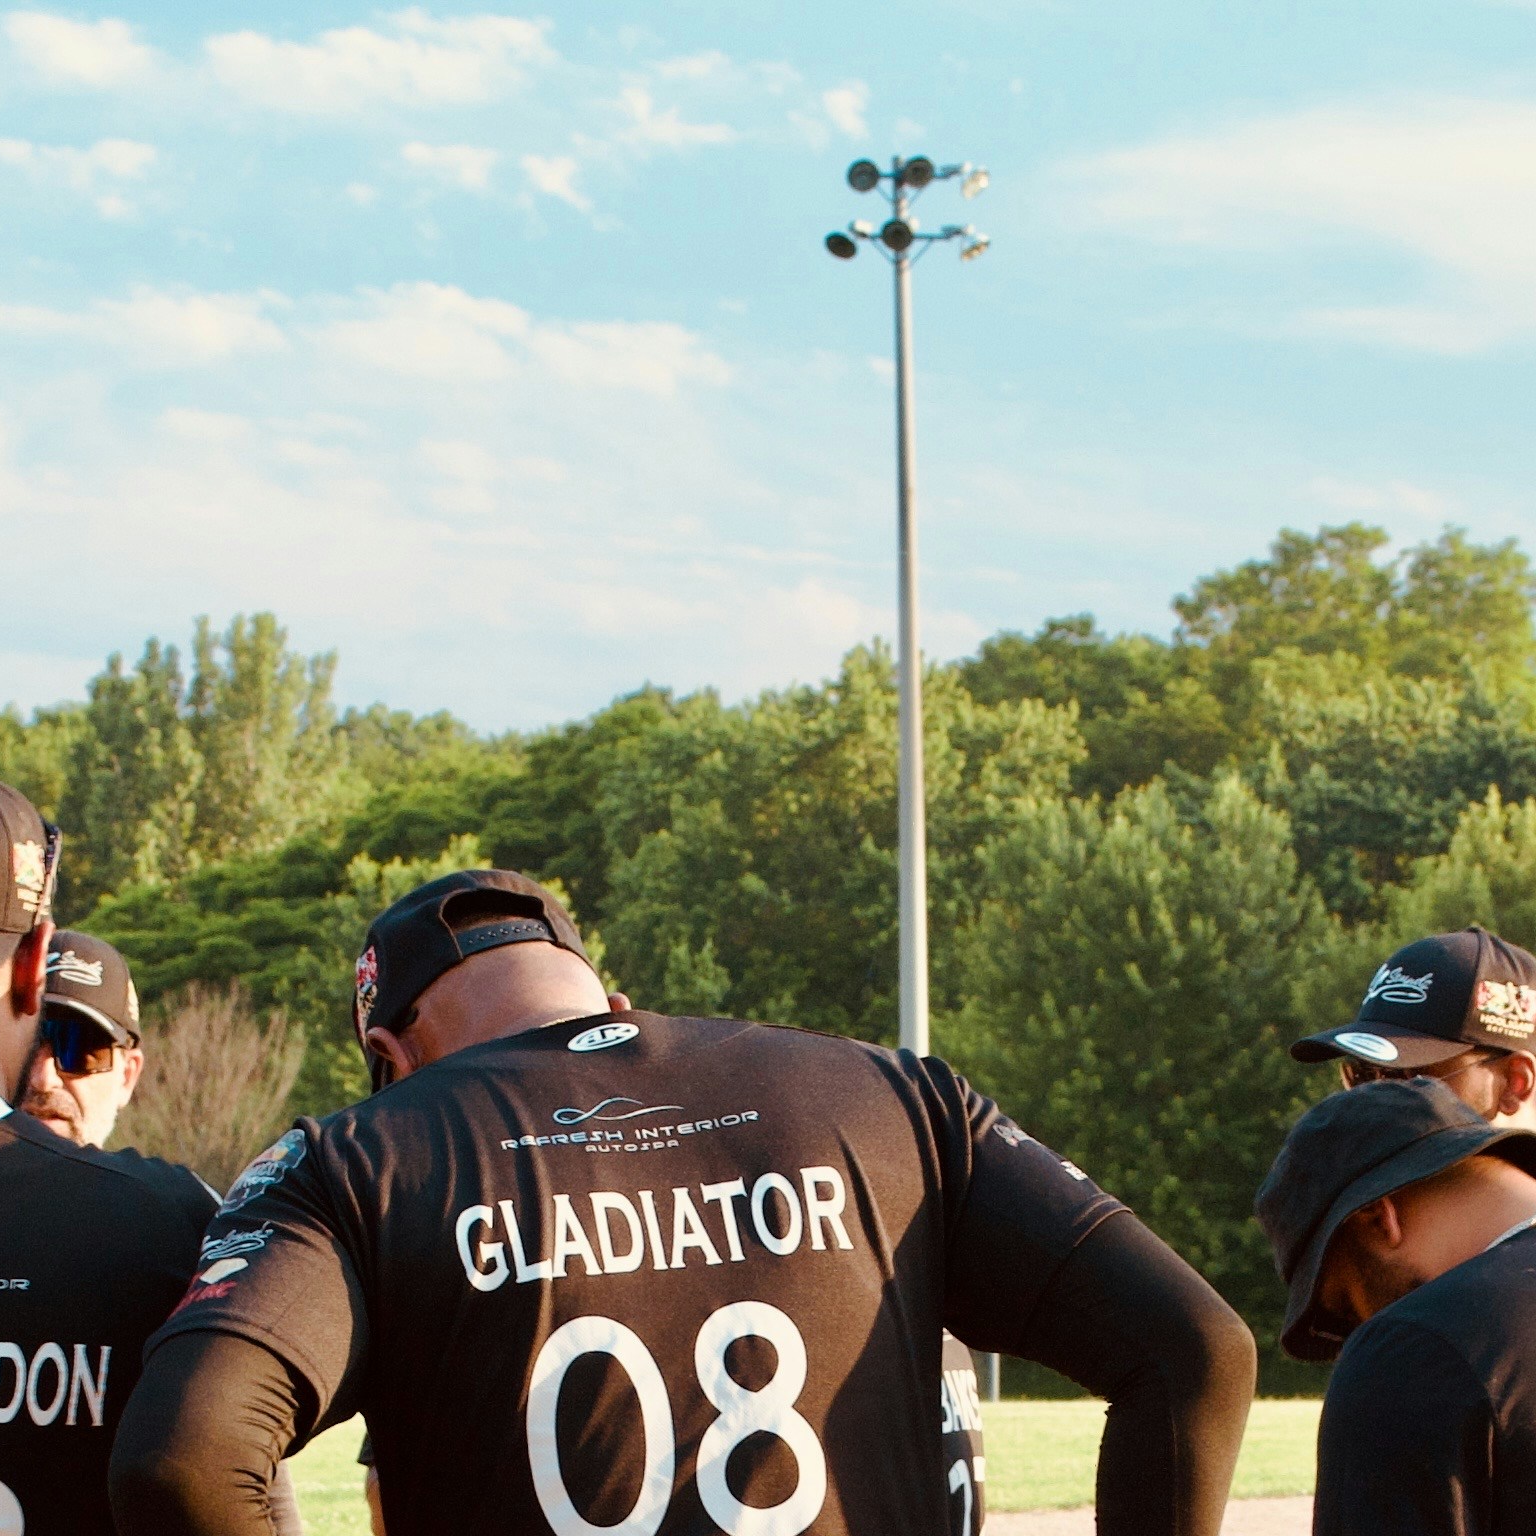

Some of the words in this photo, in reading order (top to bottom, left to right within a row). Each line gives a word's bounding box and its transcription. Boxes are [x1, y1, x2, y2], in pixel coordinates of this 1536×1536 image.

[500, 1130, 624, 1151] REFRESH
[635, 1110, 760, 1140] INTERIOR
[585, 1139, 680, 1153] AUTOSPA
[455, 1165, 855, 1293] GLADIATOR
